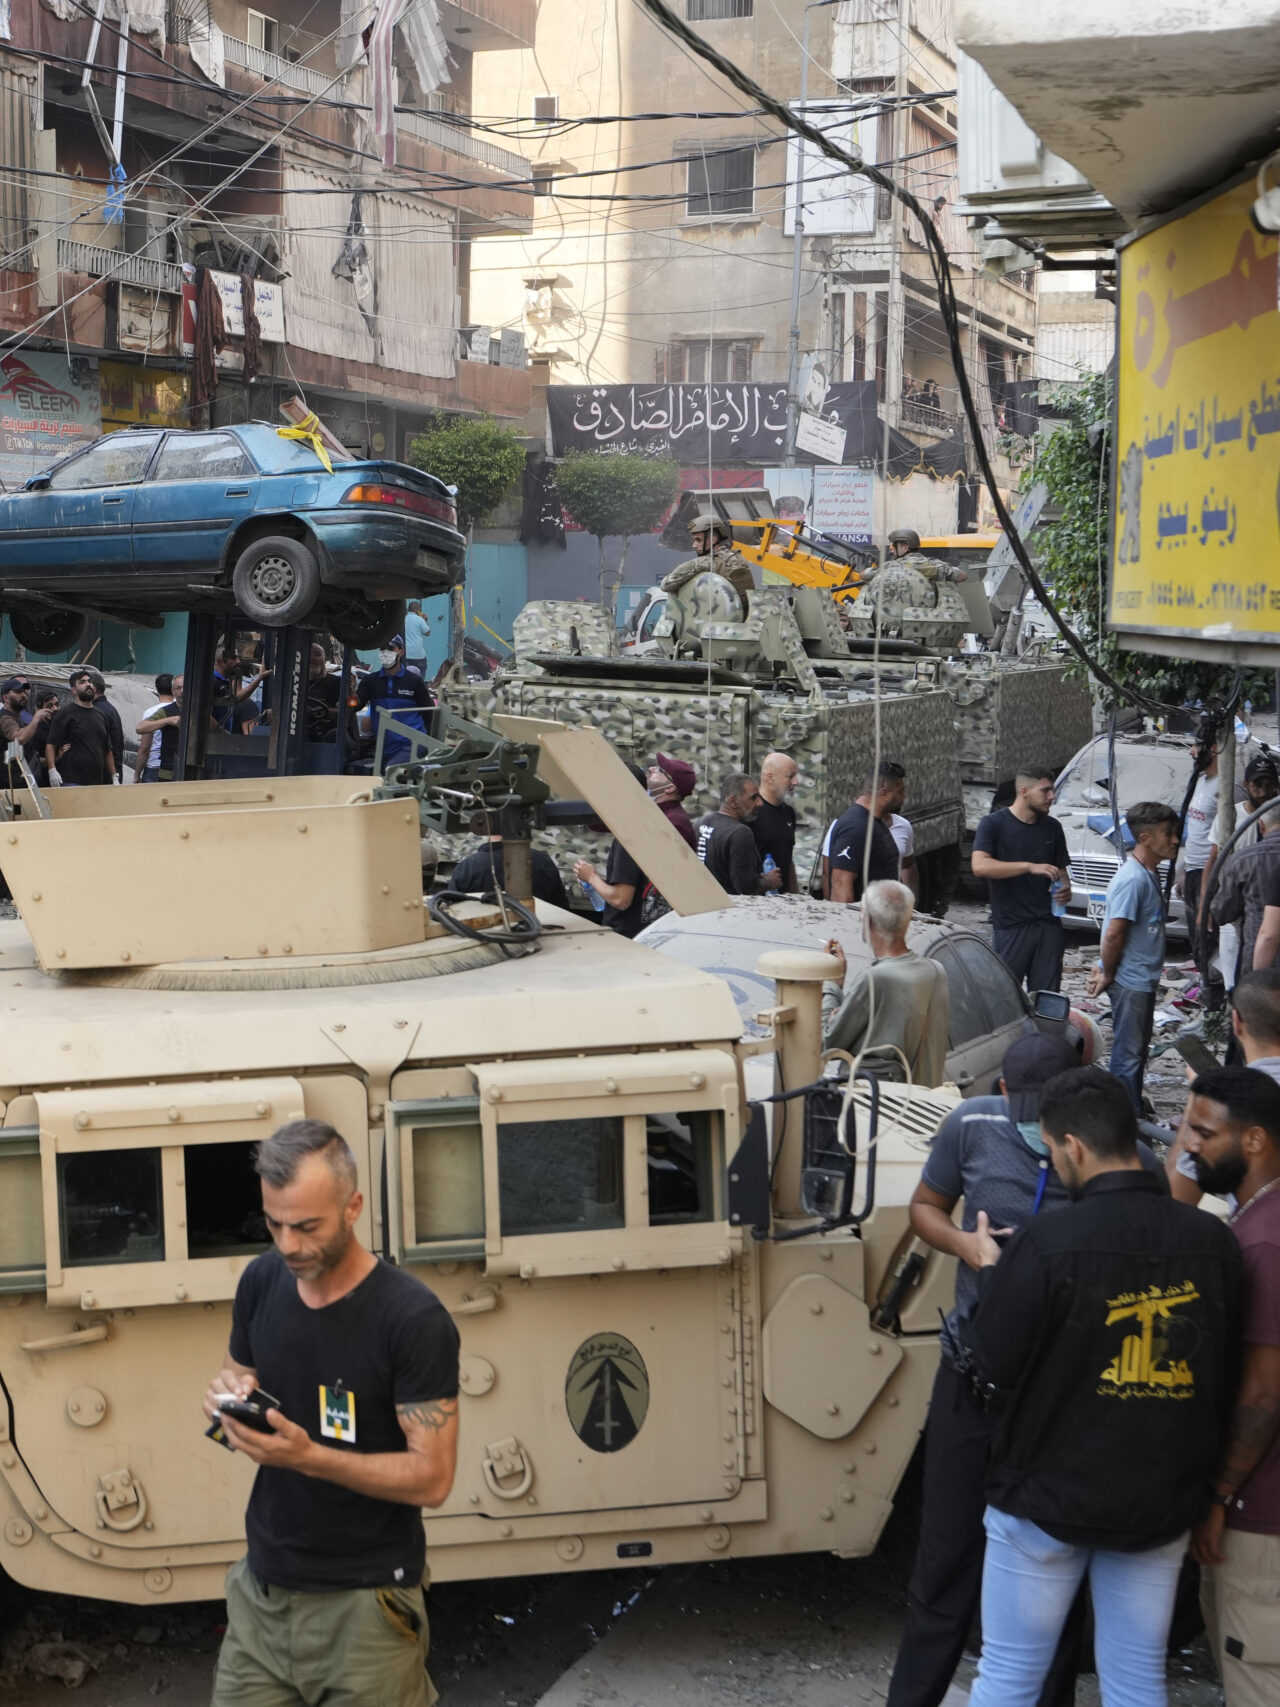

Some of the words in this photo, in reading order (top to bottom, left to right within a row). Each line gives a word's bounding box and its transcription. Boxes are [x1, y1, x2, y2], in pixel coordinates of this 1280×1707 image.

[18, 391, 75, 412] SLEEM
[2, 417, 39, 435] السيارات
[40, 420, 59, 436] لزينة
[61, 423, 83, 438] سليم
[1183, 396, 1243, 460] سيارات
[1199, 487, 1237, 546] رينو
[289, 650, 302, 736] KOMATSU
